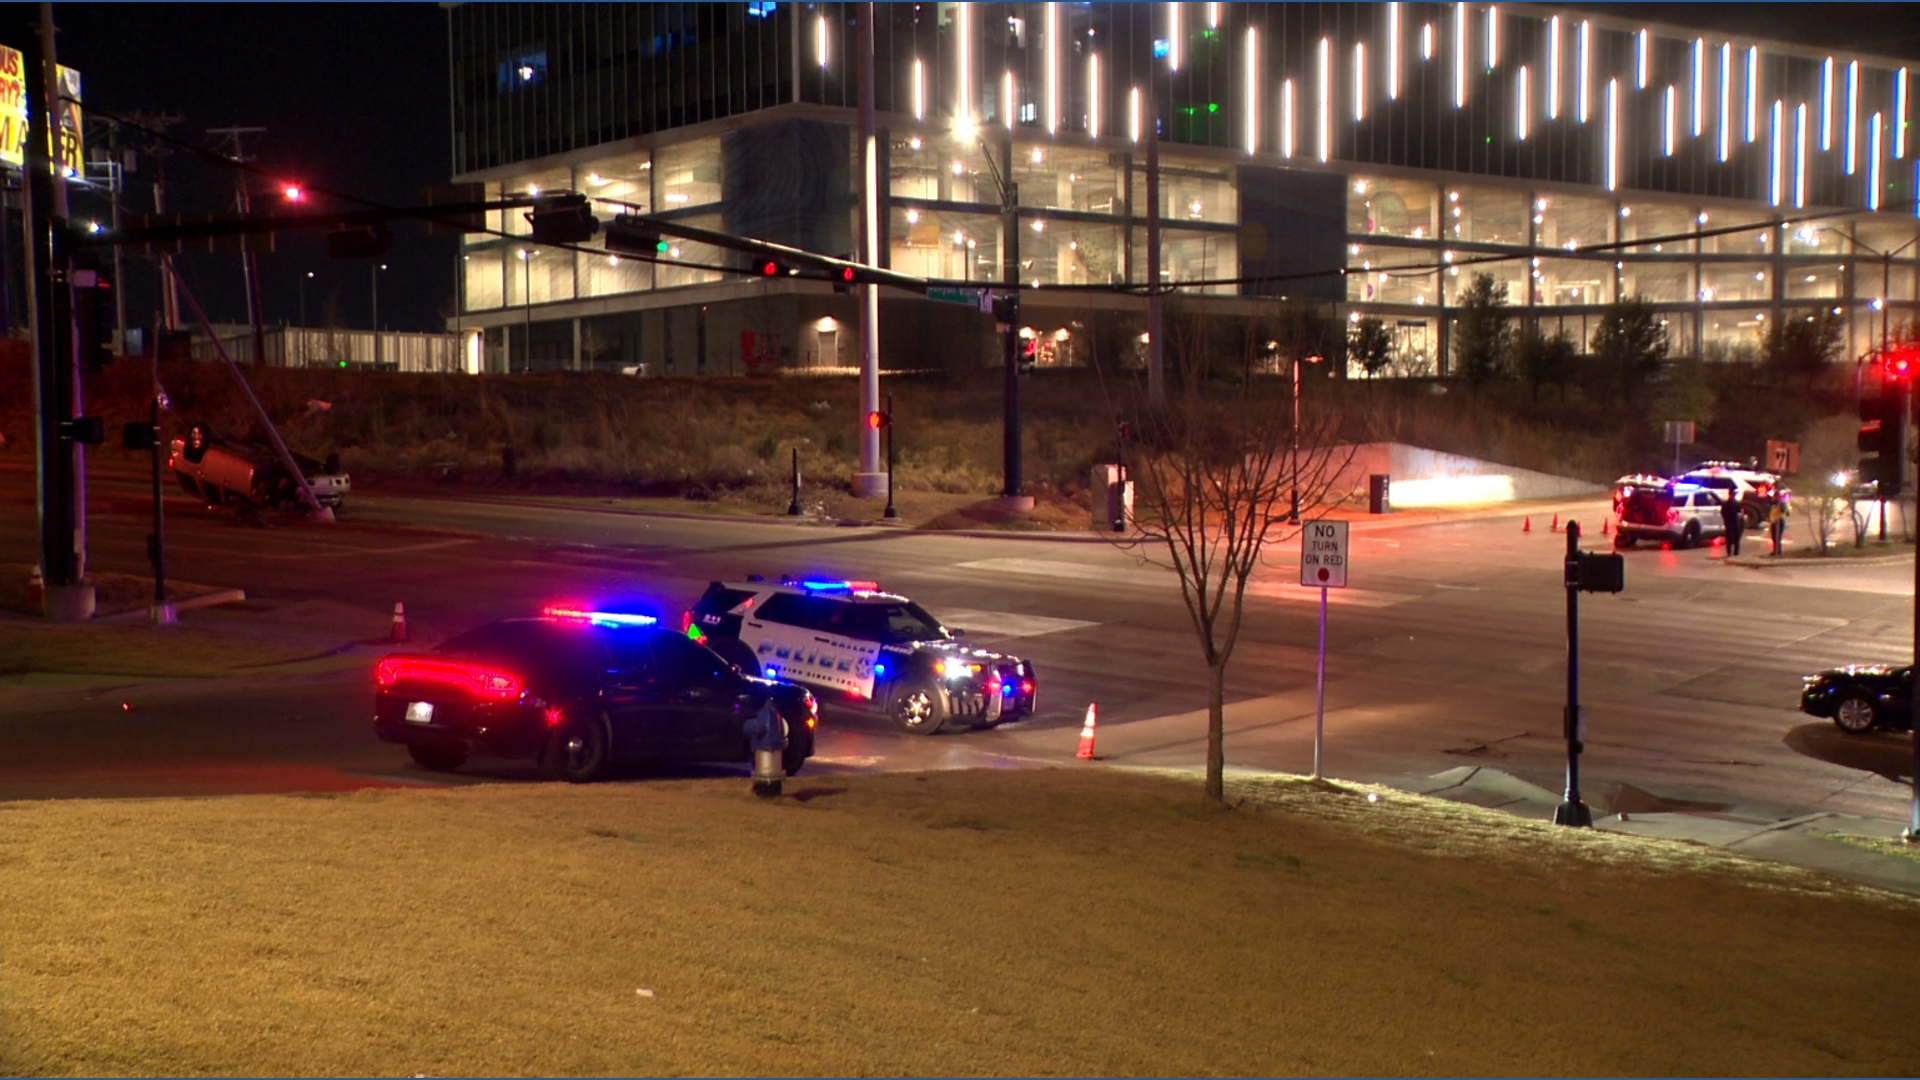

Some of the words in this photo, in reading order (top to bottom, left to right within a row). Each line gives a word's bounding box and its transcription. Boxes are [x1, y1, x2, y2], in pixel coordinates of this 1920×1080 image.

[0, 48, 18, 77] US
[1315, 525, 1335, 538] NO
[1312, 540, 1338, 551] TURN
[1305, 554, 1319, 565] ON
[1324, 554, 1343, 566] RED
[831, 641, 874, 654] DALLAS
[758, 638, 853, 672] POLICE
[806, 671, 833, 682] SINCE
